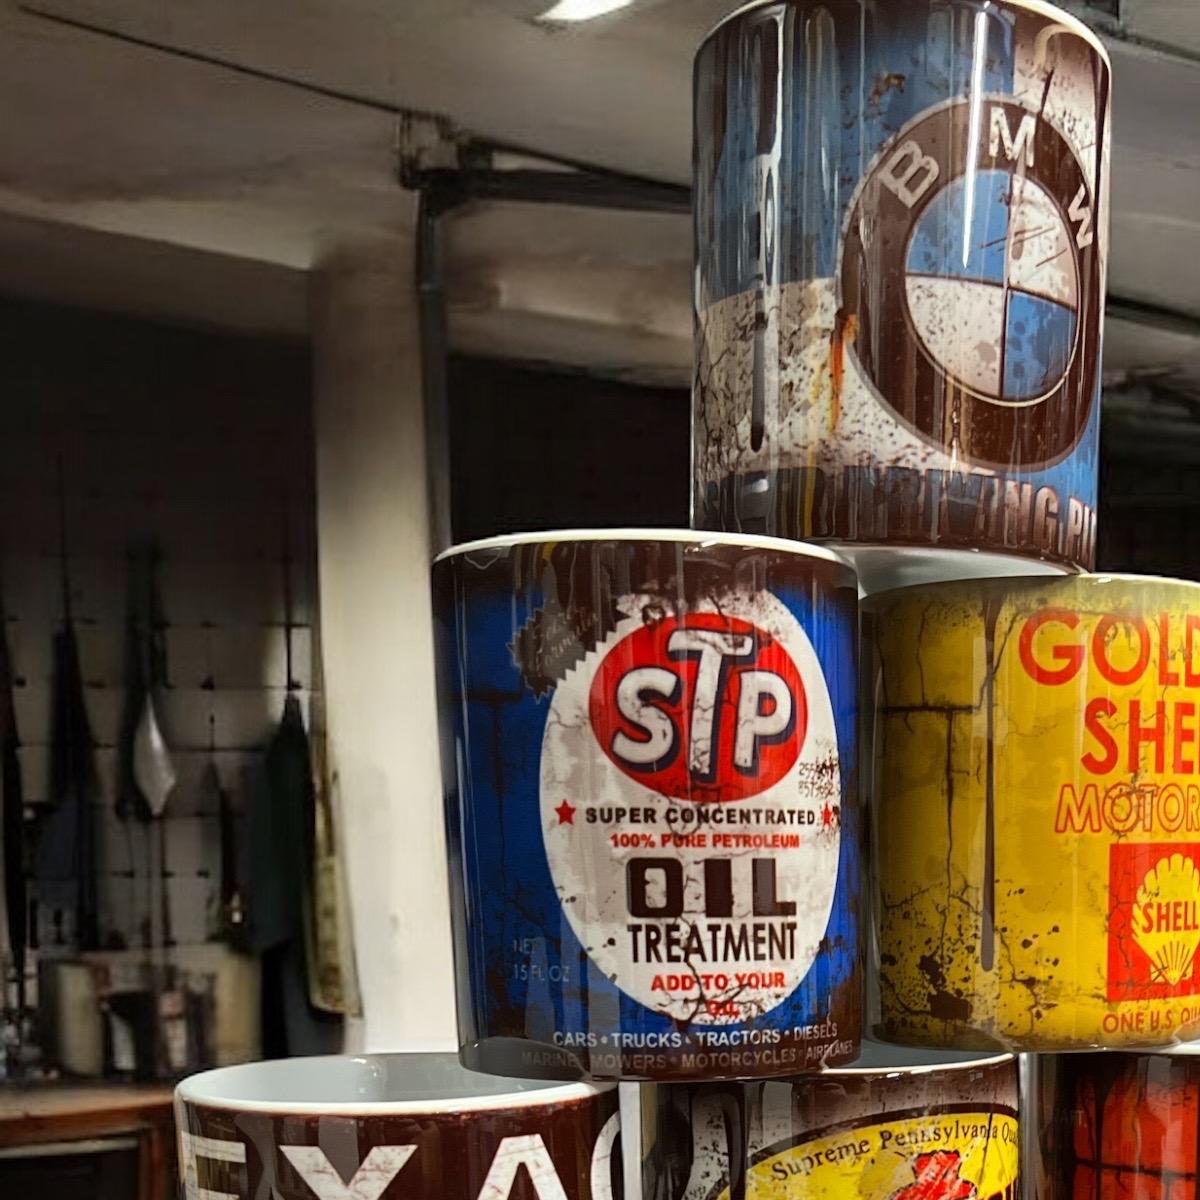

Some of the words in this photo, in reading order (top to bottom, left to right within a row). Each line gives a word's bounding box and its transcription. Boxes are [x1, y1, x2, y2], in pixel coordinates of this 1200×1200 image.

[612, 629, 795, 782] STP
[586, 808, 657, 825] SUPER
[665, 807, 815, 825] CONCENTRATED
[1055, 783, 1200, 833] MOTOR
[610, 833, 655, 849] 100%
[661, 833, 707, 849] PURE
[712, 833, 800, 849] PETROLEUM
[626, 857, 797, 918] OIL
[1141, 900, 1200, 933] SHELL
[627, 922, 797, 964] TREATMENT
[651, 972, 695, 991] ADD
[701, 973, 729, 990] TO
[735, 971, 786, 990] YOUR
[552, 1030, 598, 1048] CARS
[611, 1031, 682, 1049] TRUCKS
[696, 1028, 781, 1047] TRACTORS
[793, 1021, 839, 1042] DIESELS
[1103, 1009, 1144, 1034] ONE
[591, 1053, 667, 1070] MOWERS
[681, 1047, 796, 1069] MOTORCYCLES
[771, 1137, 871, 1182] Supreme
